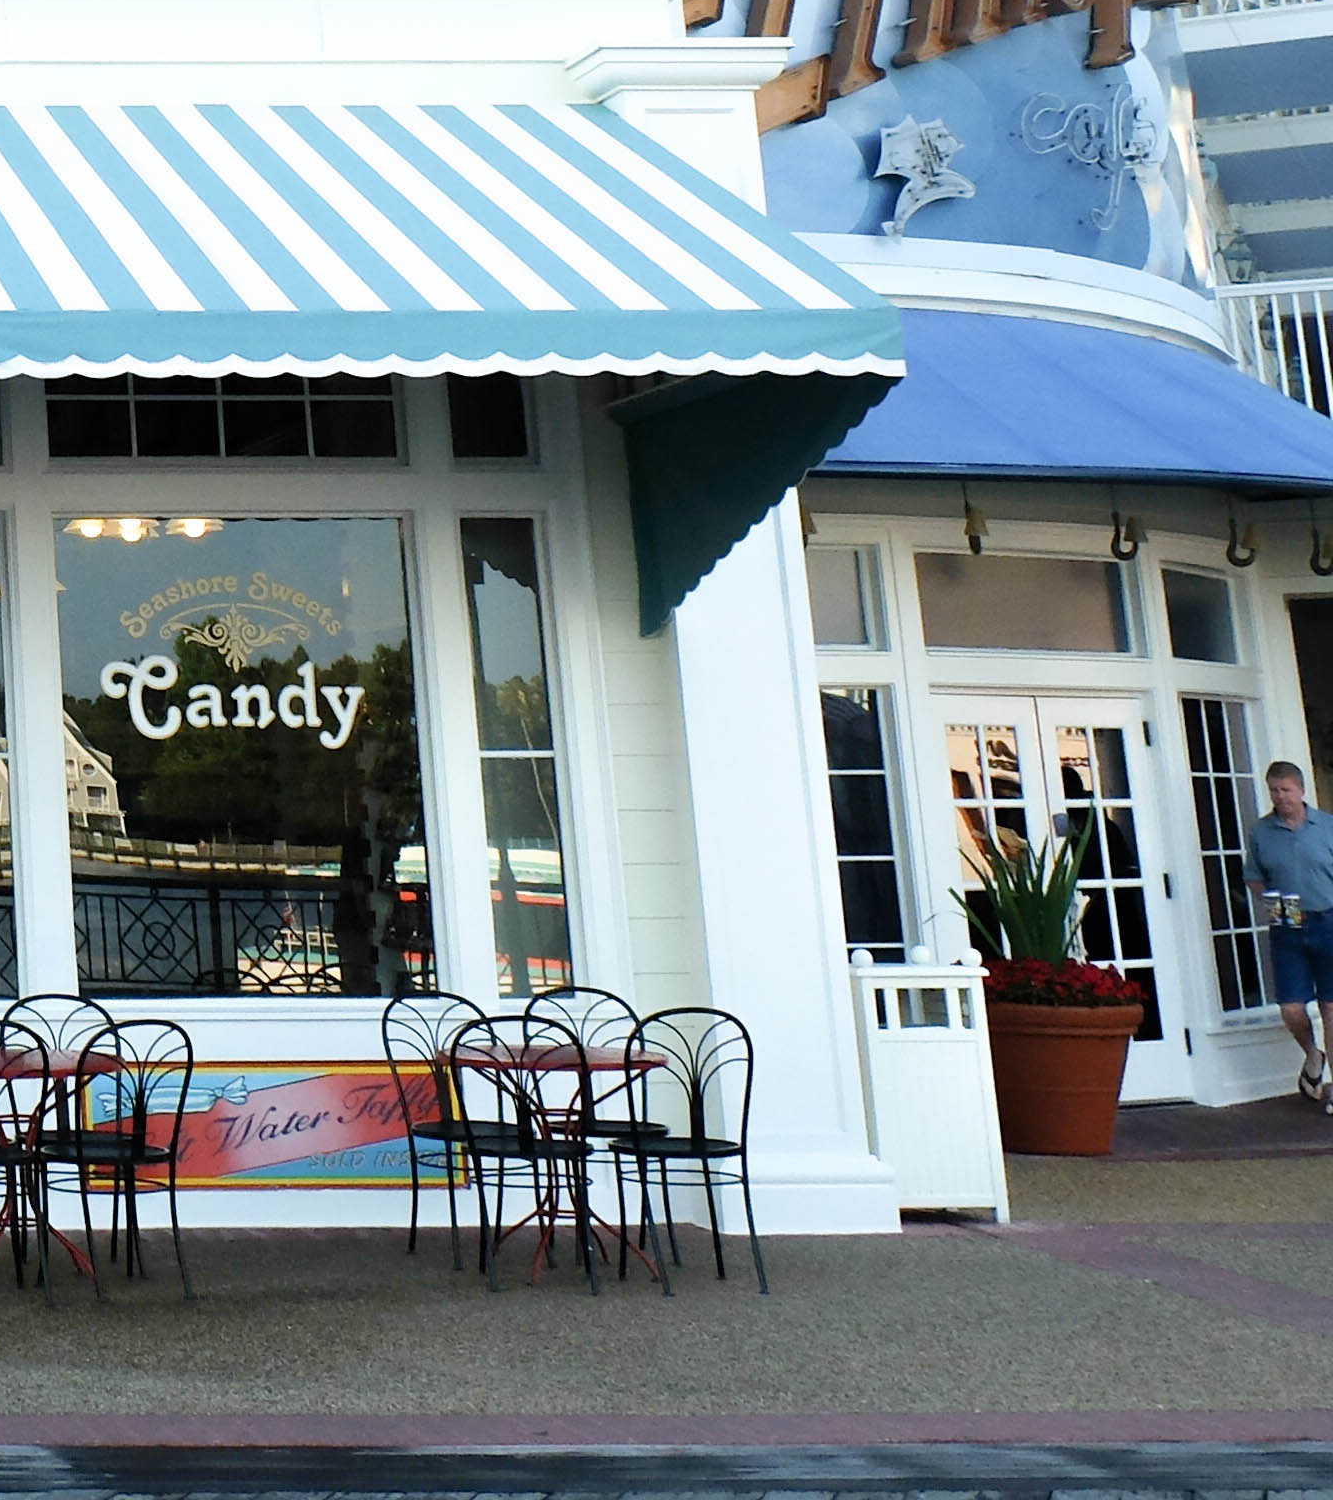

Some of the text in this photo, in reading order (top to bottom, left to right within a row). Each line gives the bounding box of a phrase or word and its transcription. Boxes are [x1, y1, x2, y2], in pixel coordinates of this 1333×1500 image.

[119, 572, 342, 638] Seashore Sweets
[100, 655, 365, 750] Candy
[205, 1106, 331, 1158] Water
[309, 1150, 364, 1170] SOLD
